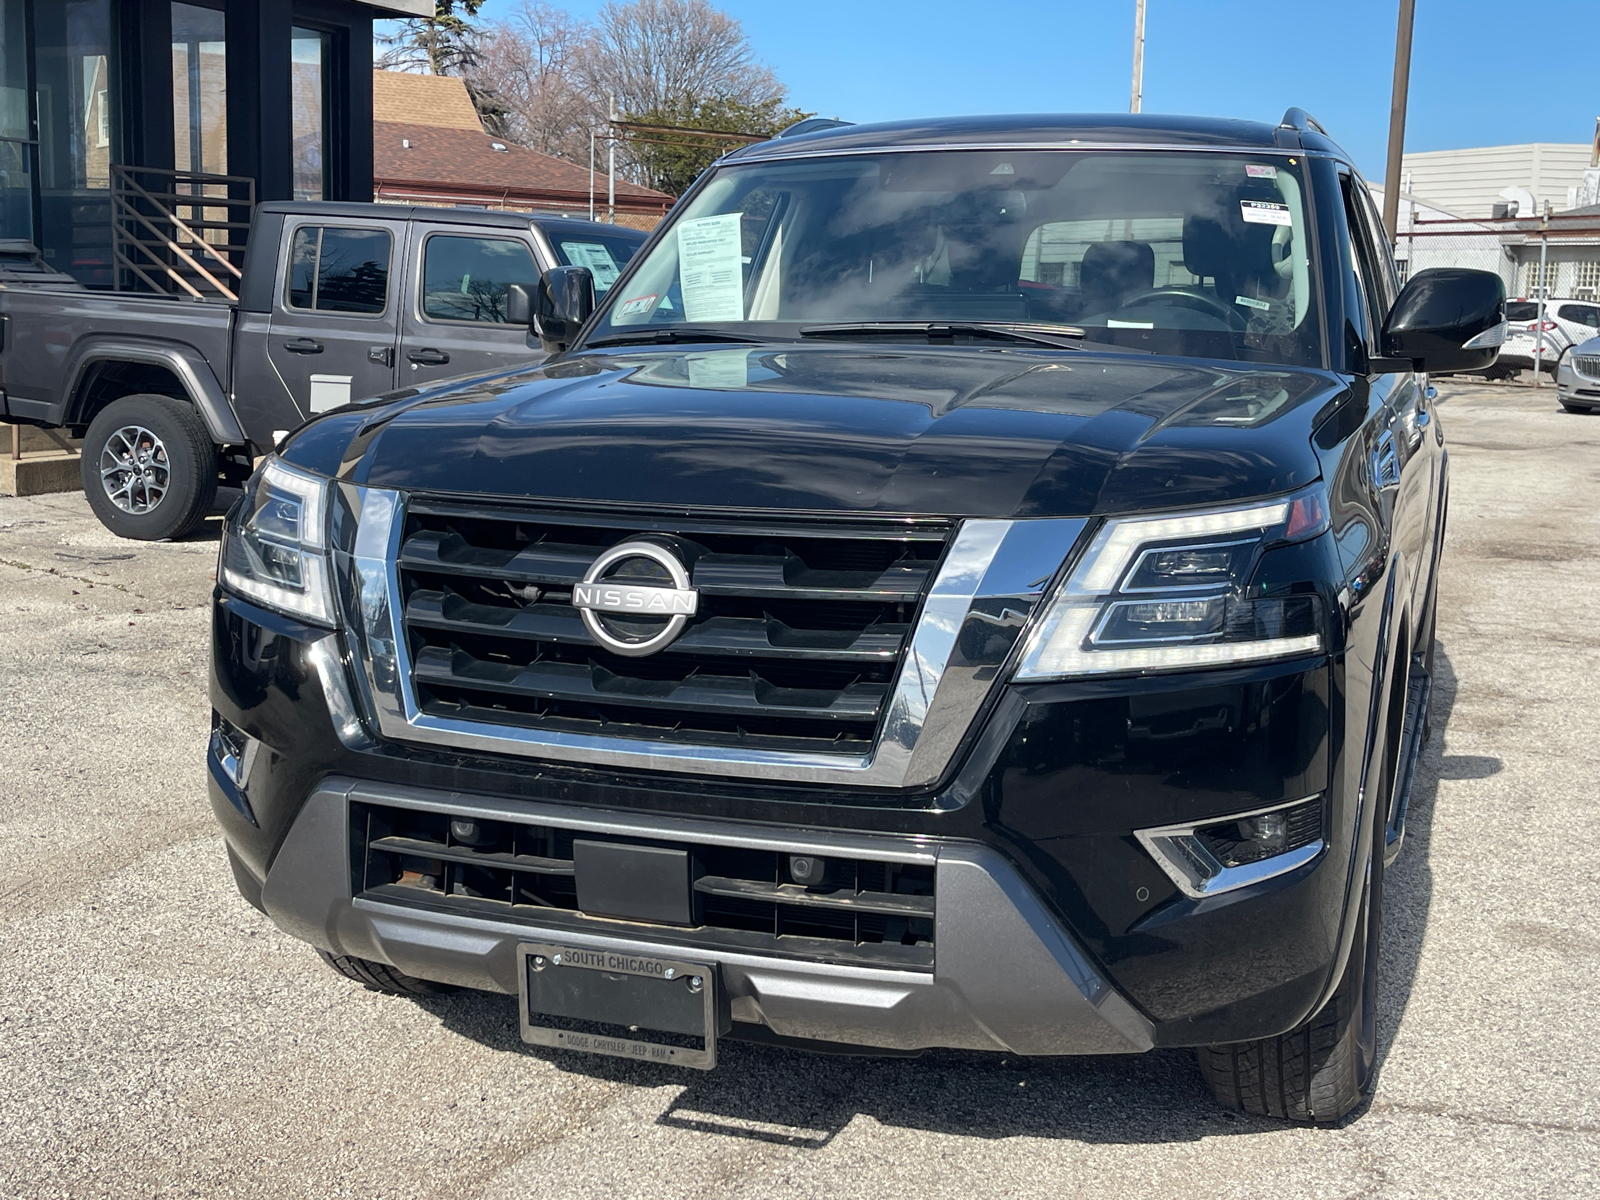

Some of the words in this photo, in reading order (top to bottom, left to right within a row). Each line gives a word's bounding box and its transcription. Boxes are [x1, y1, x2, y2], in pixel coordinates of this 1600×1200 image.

[575, 587, 692, 611] NISSAN
[564, 950, 605, 967] SOUTH
[608, 956, 663, 975] CHICAGO
[567, 1034, 588, 1047] DODGE
[593, 1038, 626, 1053] CHRYSLER
[631, 1045, 647, 1056] JEEP
[651, 1047, 666, 1059] RAM
